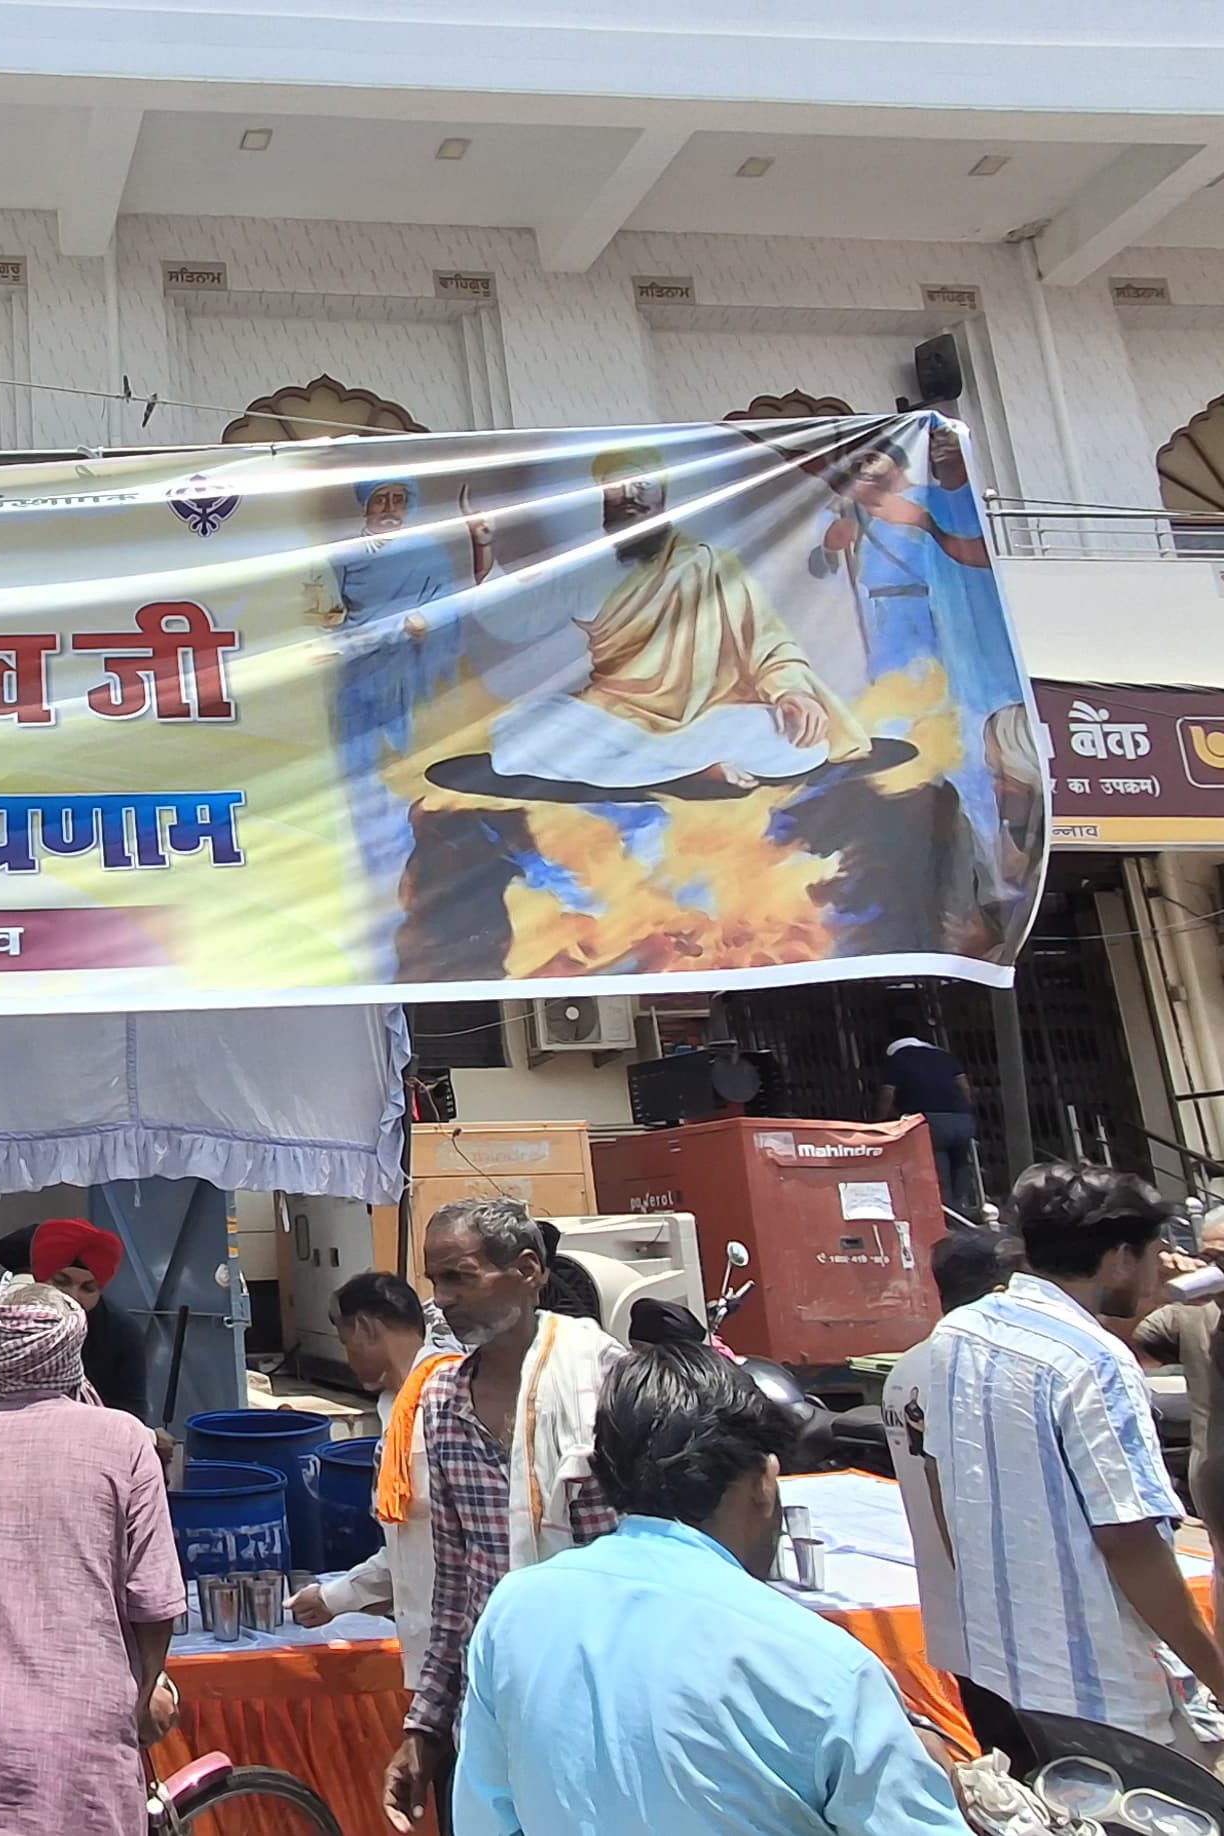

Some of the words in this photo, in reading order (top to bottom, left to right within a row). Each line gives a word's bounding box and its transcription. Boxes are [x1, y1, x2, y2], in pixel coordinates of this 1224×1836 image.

[167, 267, 222, 284] ਸਤਿਨਾਮ
[70, 600, 240, 724] जी
[1067, 778, 1091, 794] का
[1099, 775, 1161, 797] उपक्रम)
[1051, 824, 1099, 838] न्नाव
[797, 1143, 884, 1158] Mahindra
